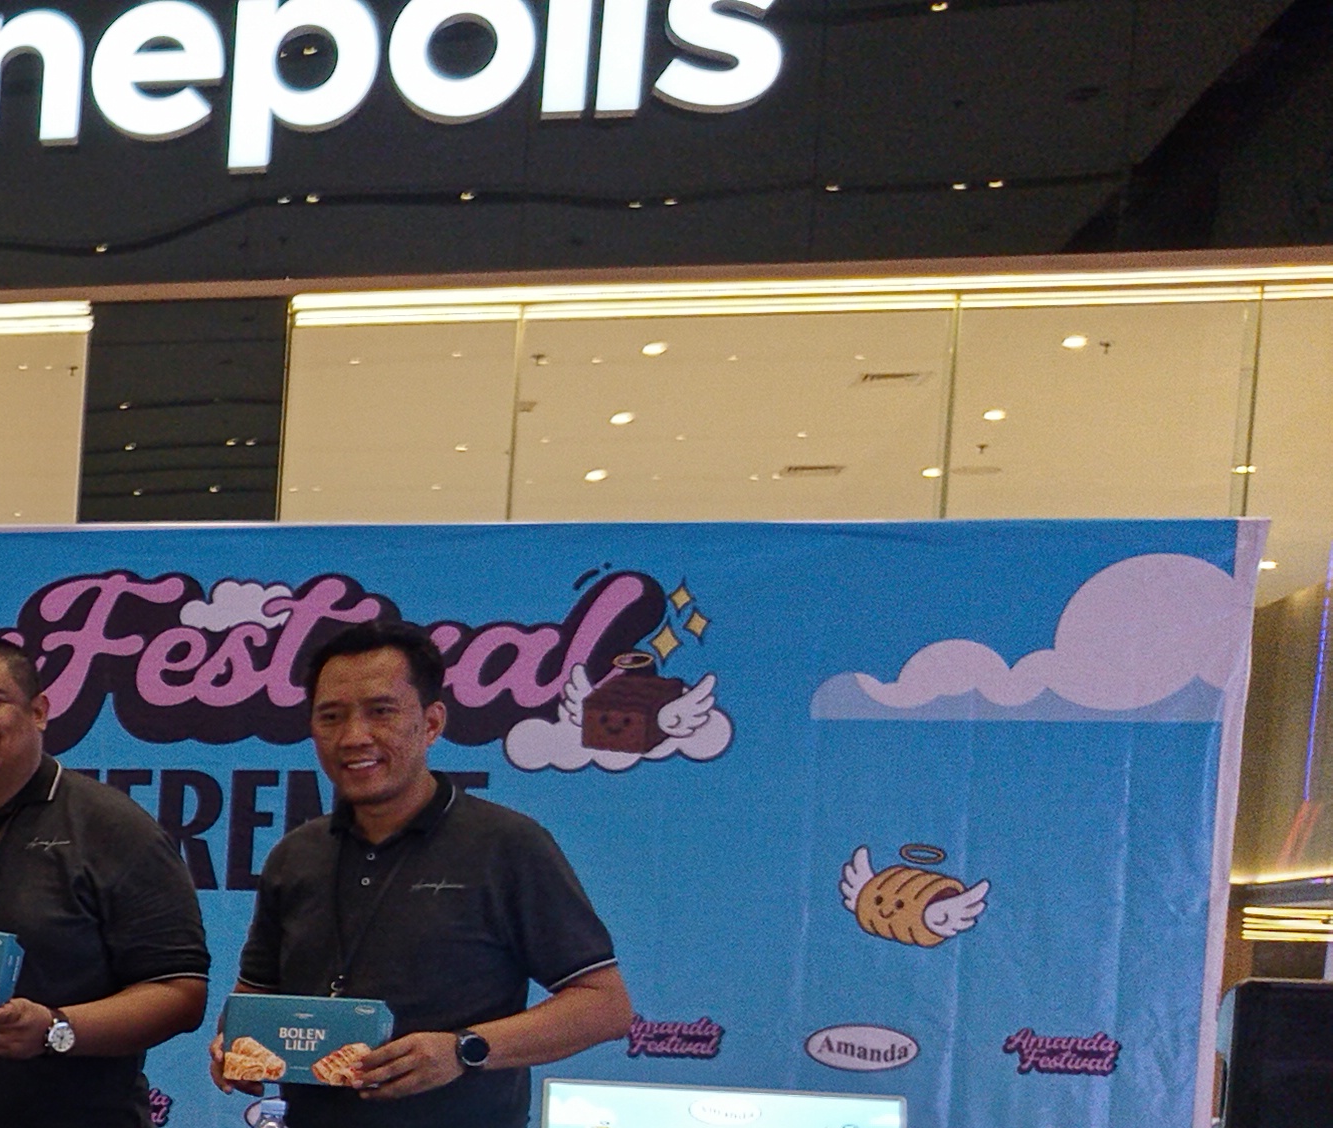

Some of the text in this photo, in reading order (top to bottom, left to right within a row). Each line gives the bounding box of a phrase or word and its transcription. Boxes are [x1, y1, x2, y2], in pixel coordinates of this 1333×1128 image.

[278, 1026, 326, 1041] BOLEN
[1006, 1027, 1120, 1051] Amanda
[285, 1039, 318, 1052] LILIT
[630, 1034, 720, 1055] Festival
[818, 1034, 910, 1063] Amanda
[1021, 1049, 1115, 1071] Festival
